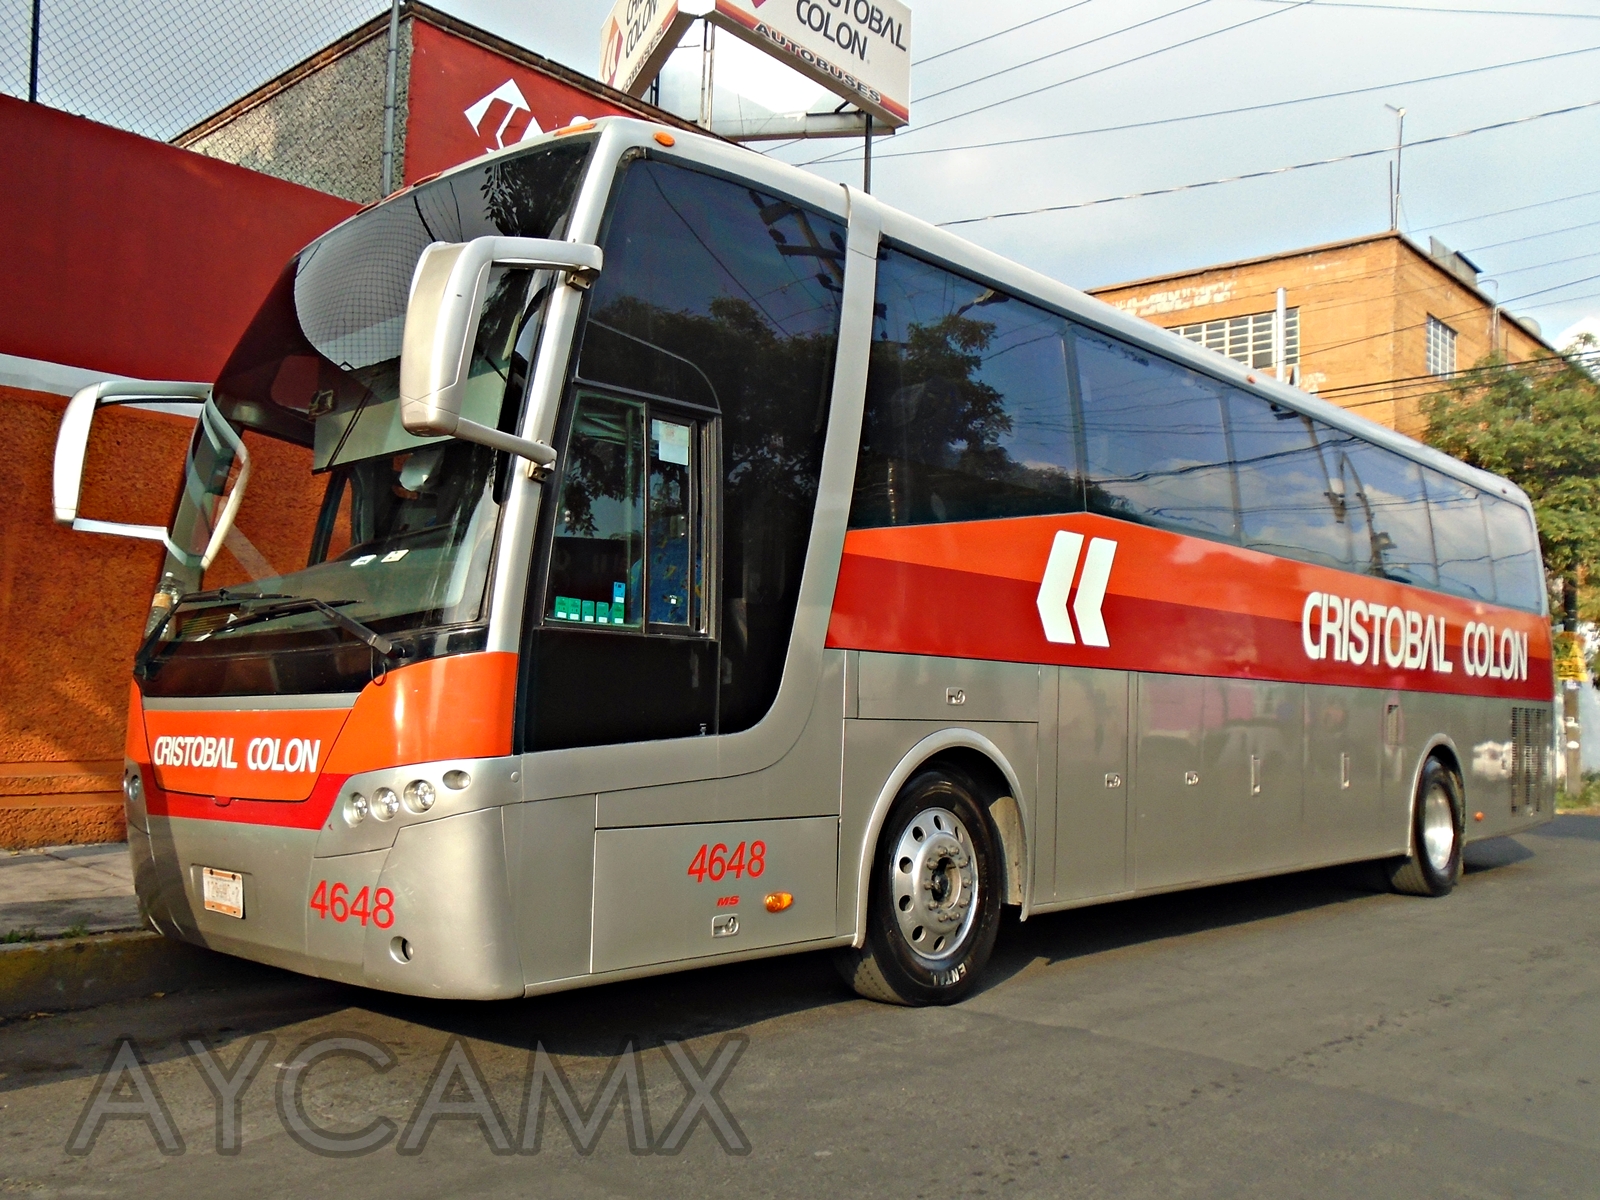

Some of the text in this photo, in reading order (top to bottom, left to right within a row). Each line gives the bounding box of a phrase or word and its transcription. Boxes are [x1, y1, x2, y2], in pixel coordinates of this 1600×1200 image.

[796, 0, 868, 61] COLON
[755, 22, 880, 102] AUTOBUSES
[1302, 591, 1528, 681] CRISTOBAL COLON
[153, 735, 321, 773] CRISTOBAL COLON
[687, 839, 767, 883] 4648
[310, 879, 396, 929] 4648
[717, 895, 740, 907] MS
